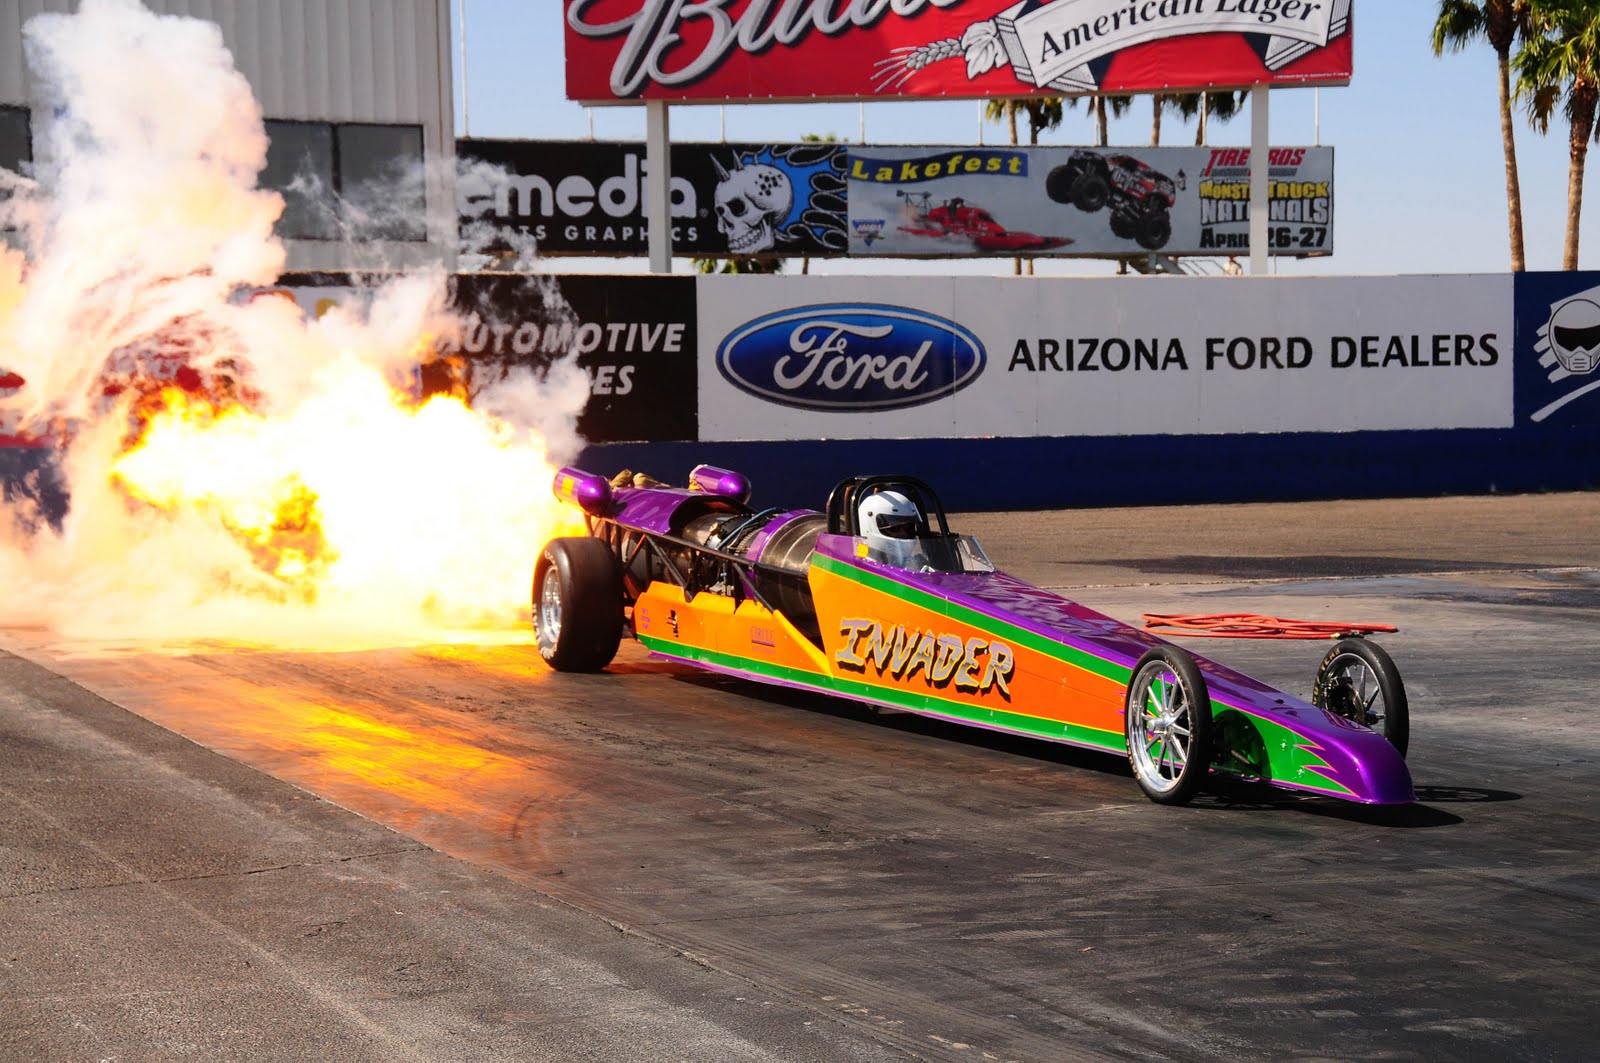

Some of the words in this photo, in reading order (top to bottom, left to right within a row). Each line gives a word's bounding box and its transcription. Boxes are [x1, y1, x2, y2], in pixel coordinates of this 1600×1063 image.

[1040, 0, 1203, 63] American
[851, 155, 1022, 182] Lakefest
[1204, 148, 1251, 177] TIRE
[1267, 148, 1306, 166] ROS
[1199, 180, 1250, 199] MONST
[1201, 198, 1328, 224] NATNALS
[564, 225, 698, 241] GRAPHCS
[773, 320, 933, 390] Ford
[1008, 338, 1189, 372] ARIZONA
[1206, 337, 1312, 371] FORD
[1331, 333, 1499, 368] DEALERS
[834, 616, 1014, 701] INVADER
